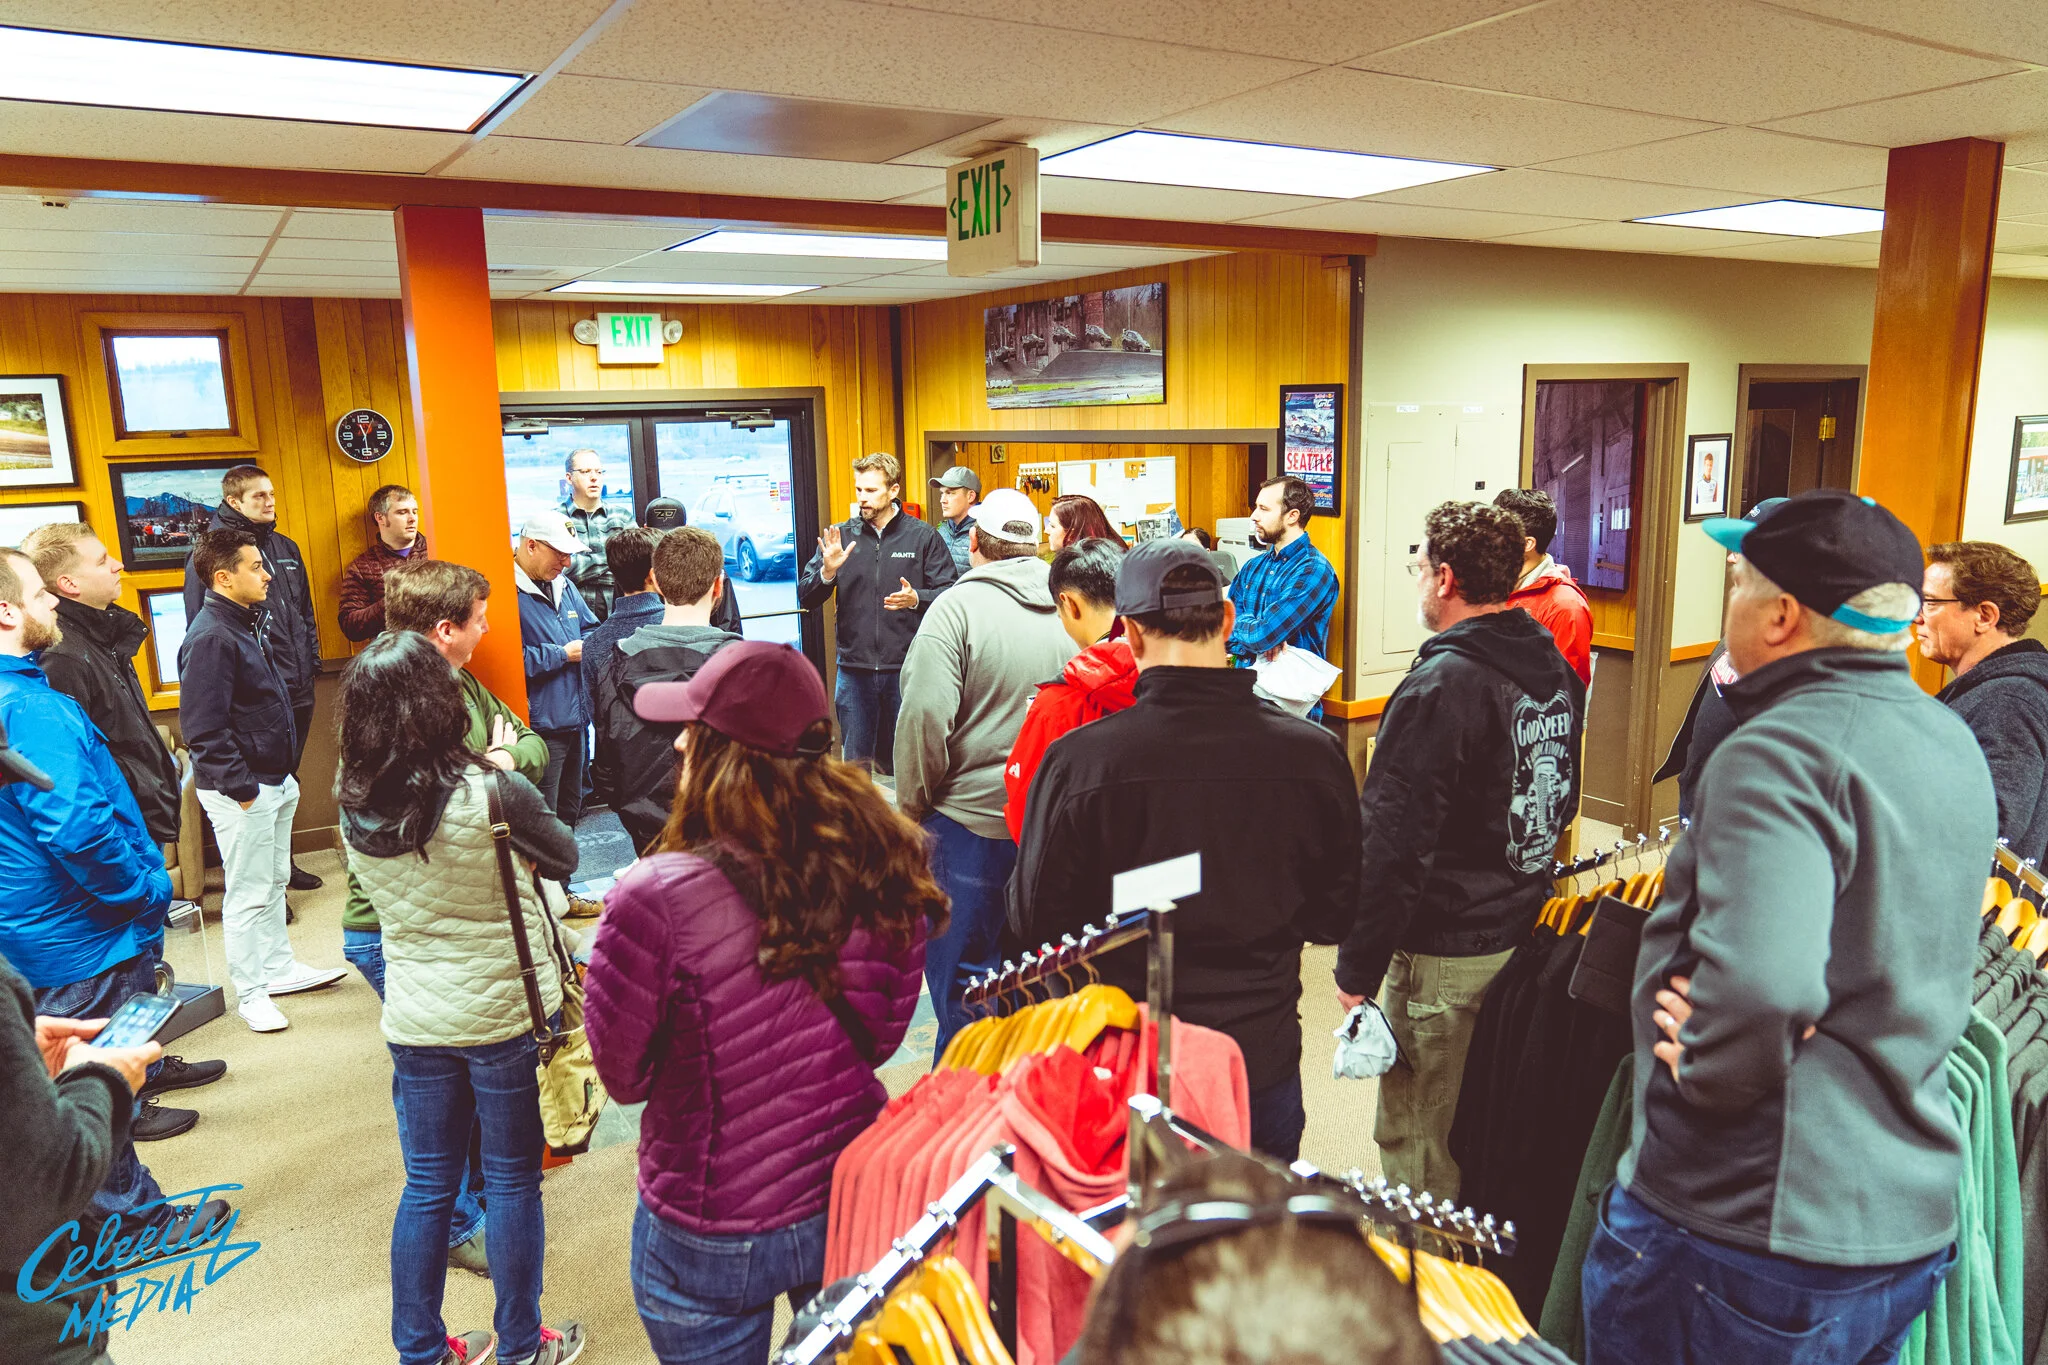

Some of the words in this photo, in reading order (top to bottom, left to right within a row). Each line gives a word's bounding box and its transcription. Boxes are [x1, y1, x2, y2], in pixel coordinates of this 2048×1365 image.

[958, 159, 1005, 241] EXIT
[610, 315, 653, 348] EXIT
[357, 415, 369, 423] 12
[342, 432, 353, 440] 9
[376, 431, 387, 440] 3
[1286, 452, 1333, 472] SEATTLE
[890, 551, 916, 559] AVANTS
[1516, 712, 1570, 747] GODSPEED
